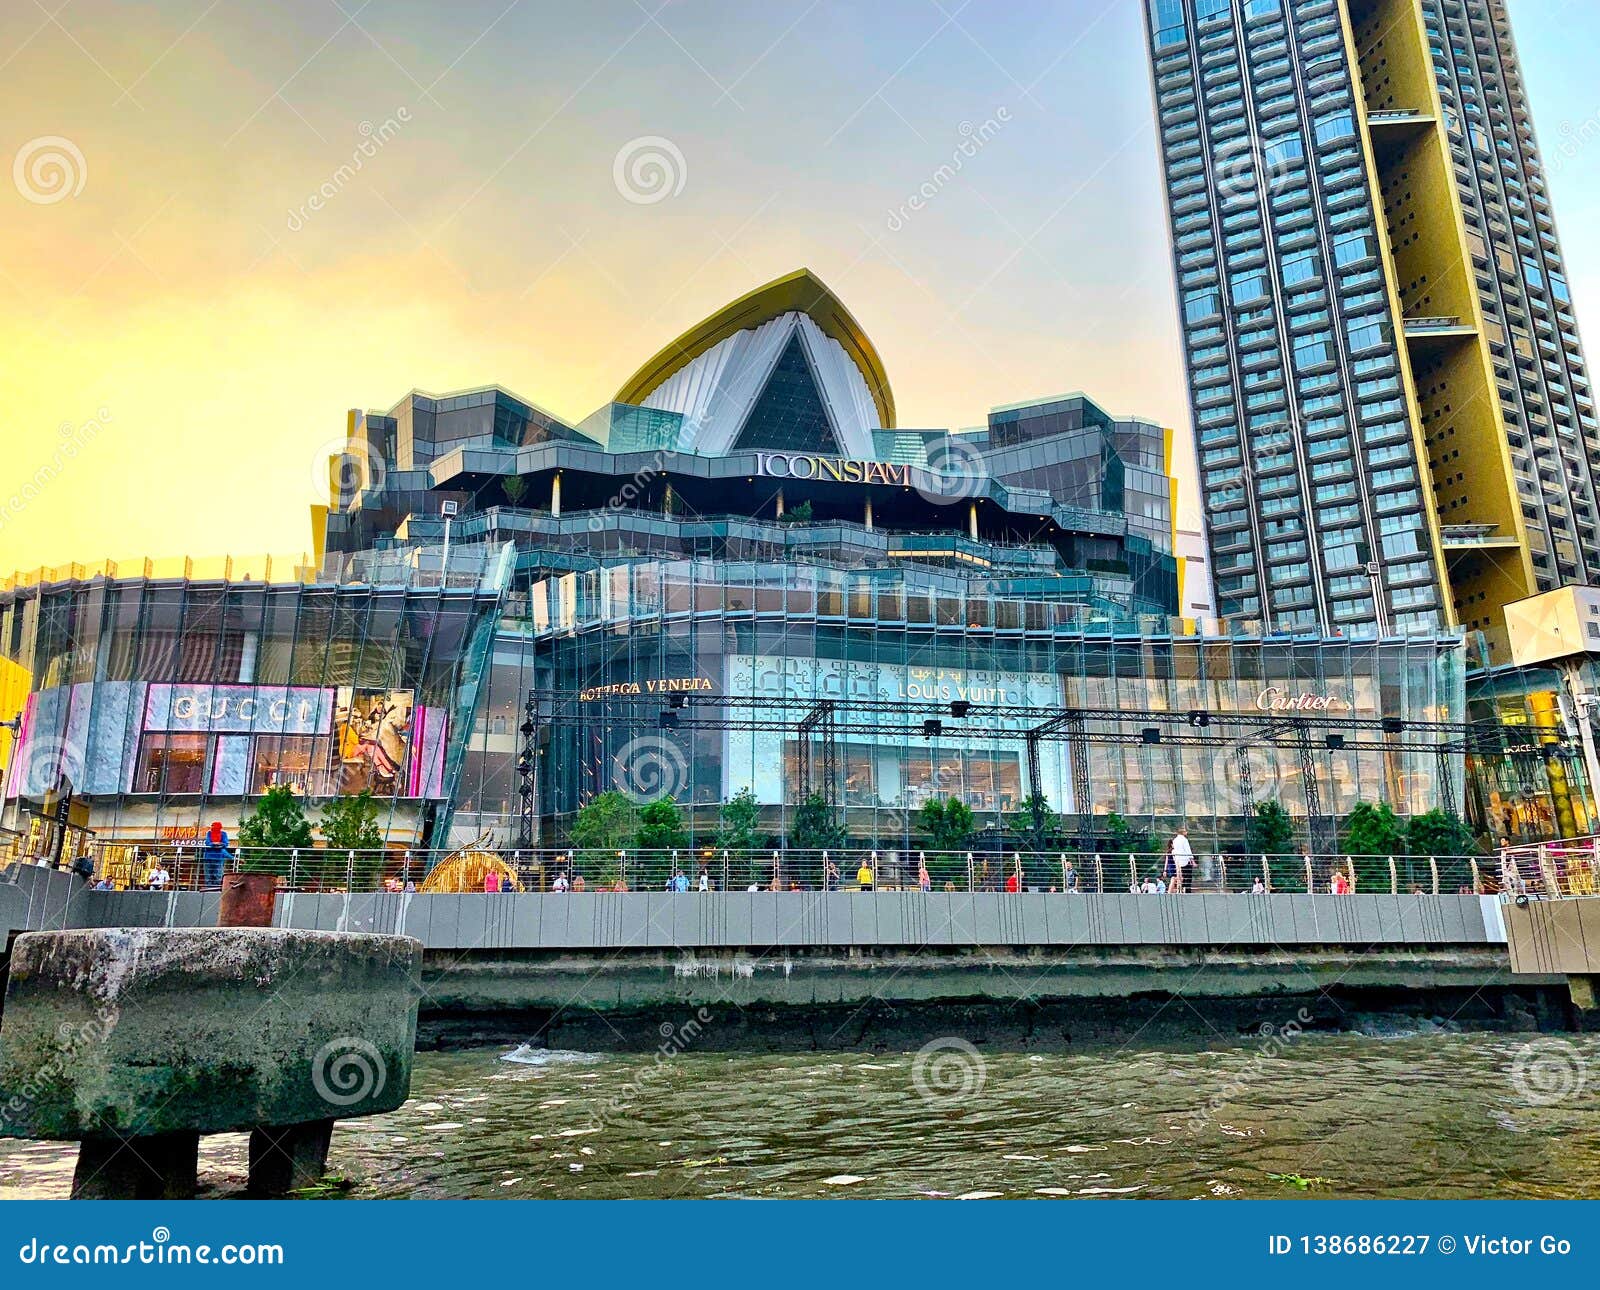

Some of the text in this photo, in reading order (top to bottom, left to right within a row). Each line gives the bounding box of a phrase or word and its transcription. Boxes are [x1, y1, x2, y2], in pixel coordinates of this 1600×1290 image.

[755, 453, 911, 486] ICONSIAM
[646, 678, 712, 691] VENETA
[898, 683, 950, 700] LOUIS
[175, 697, 308, 722] GUCCI
[1257, 687, 1337, 711] Cartier
